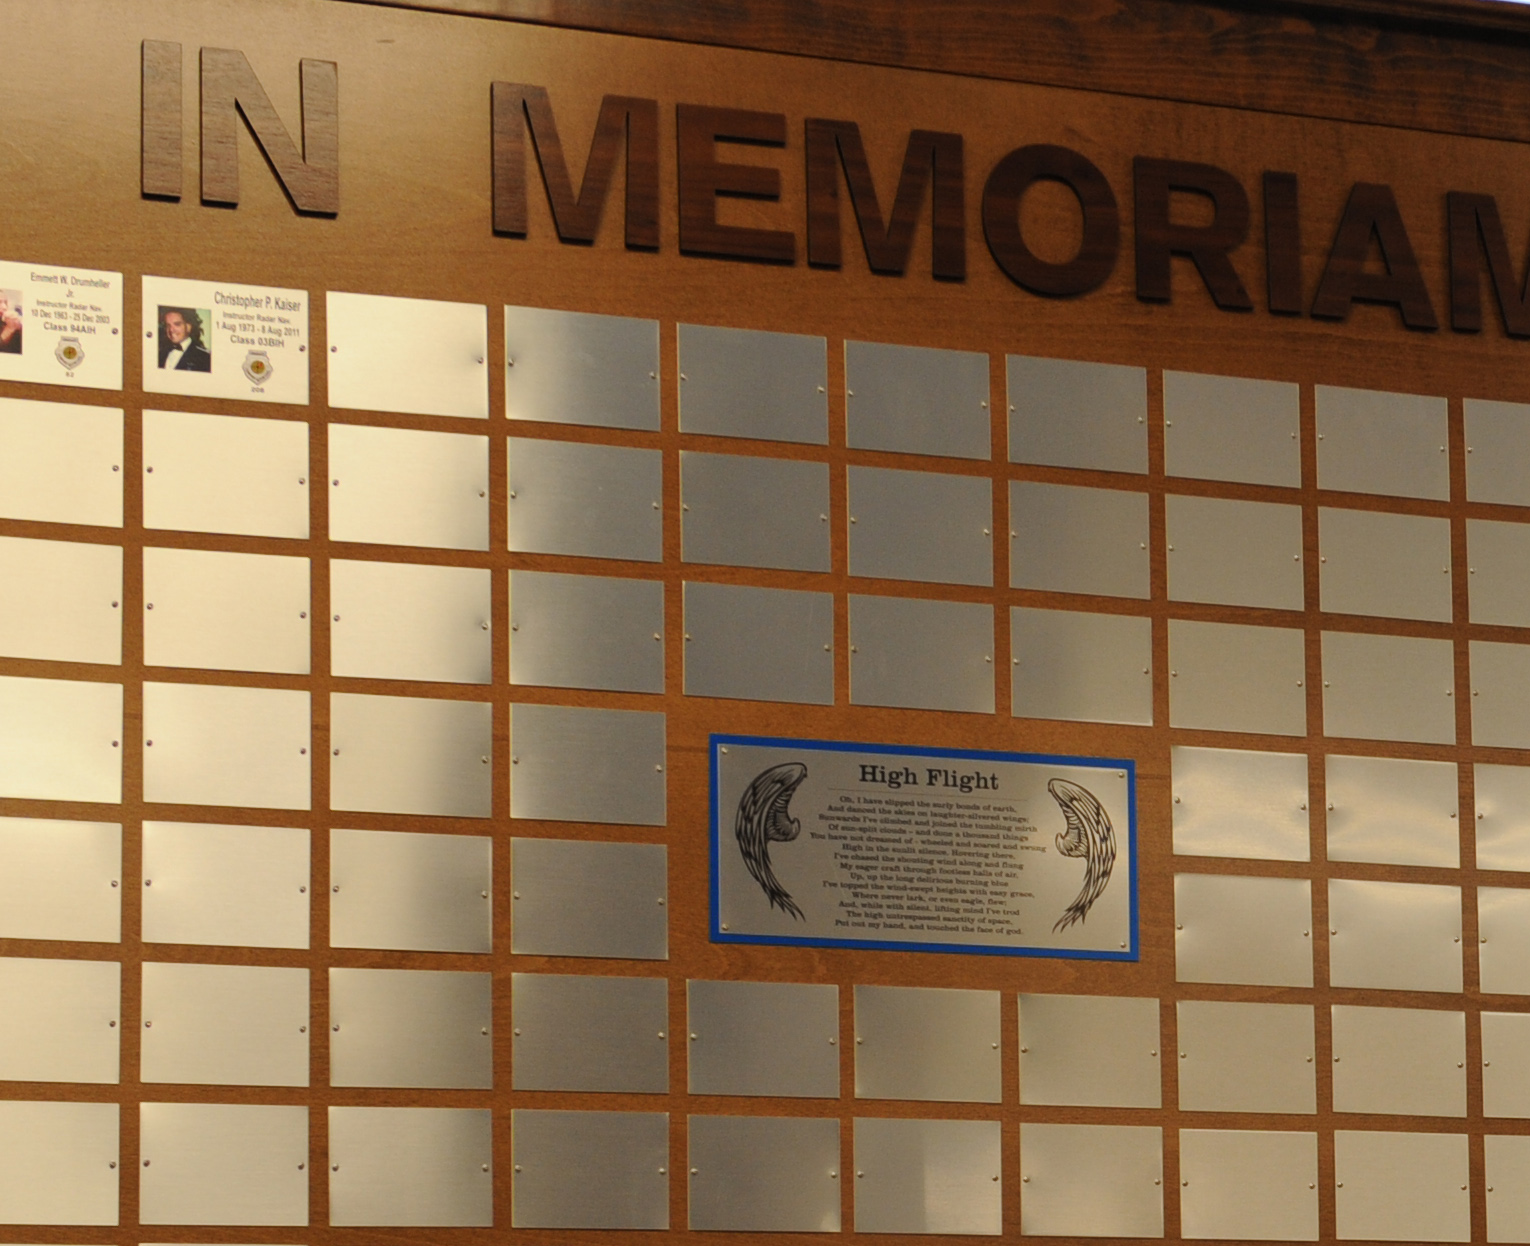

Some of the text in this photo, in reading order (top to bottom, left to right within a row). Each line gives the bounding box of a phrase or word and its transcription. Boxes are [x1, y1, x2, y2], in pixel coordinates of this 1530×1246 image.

[140, 37, 340, 220] IN
[31, 271, 110, 288] Emmett W. Drumheller
[66, 289, 74, 298] Jr.
[214, 291, 302, 312] Christopher P. Kaiser
[36, 299, 68, 308] Instructor
[69, 302, 88, 310] Radar
[40, 309, 52, 318] Dec
[82, 313, 94, 322] Dec
[222, 311, 255, 320] Instructor
[256, 314, 276, 322] Radar
[44, 322, 68, 332] Class
[222, 322, 236, 333] Aug
[239, 324, 255, 333] 1973
[267, 326, 282, 338] Aug
[284, 327, 300, 337] 2011
[230, 334, 255, 345] Class
[858, 764, 998, 795] High Flight
[826, 803, 844, 812] And
[846, 805, 876, 814] danced
[878, 806, 892, 815] the
[893, 808, 915, 816] skies
[862, 796, 883, 805] have
[884, 797, 915, 808] slipped
[916, 799, 930, 808] the
[932, 800, 954, 811] surly
[955, 802, 980, 810] bonds
[818, 812, 860, 823] Sunwards
[879, 816, 912, 825] climbed
[914, 818, 930, 826] and
[931, 819, 958, 829] joined
[959, 821, 973, 829] the
[974, 822, 1012, 832] tumbling
[1014, 824, 1038, 832] mirth
[827, 822, 839, 831] Of
[879, 826, 906, 835] clouds
[914, 828, 931, 836] and
[932, 829, 953, 837] done
[962, 830, 1000, 840] thousand
[1002, 833, 1028, 842] things
[808, 831, 1047, 853] You have not dreamed wheeled and soared and swung
[842, 842, 863, 852] High
[876, 844, 889, 852] the
[891, 845, 916, 854] sunlit
[951, 848, 989, 859] Hovering
[839, 861, 992, 877] My eager craft through footless halls
[850, 852, 879, 862] chased
[881, 854, 895, 862] the
[896, 855, 934, 866] shouting
[936, 857, 957, 866] wind
[958, 858, 982, 868] along
[984, 860, 1000, 868] and
[1001, 860, 1024, 871] flung
[879, 873, 894, 881] the
[895, 874, 914, 884] long
[916, 875, 953, 884] delirious
[954, 877, 989, 887] burning
[990, 879, 1009, 887] blue
[839, 881, 868, 891] topped
[870, 882, 884, 890] the
[935, 886, 967, 896] heights
[968, 887, 987, 895] with
[988, 889, 1007, 898] easy
[851, 890, 878, 899] Where
[880, 893, 904, 901] never
[860, 901, 883, 909] while
[885, 902, 904, 910] with
[934, 904, 960, 914] lifting
[962, 906, 984, 914] mind
[1002, 908, 1020, 916] trod
[845, 909, 862, 918] The
[864, 910, 883, 920] high
[885, 912, 940, 923] untrespassed
[942, 915, 975, 925] sanctity
[834, 918, 849, 927] Put
[908, 922, 924, 930] and
[926, 923, 959, 932] touched
[961, 924, 974, 932] the
[976, 925, 993, 933] face
